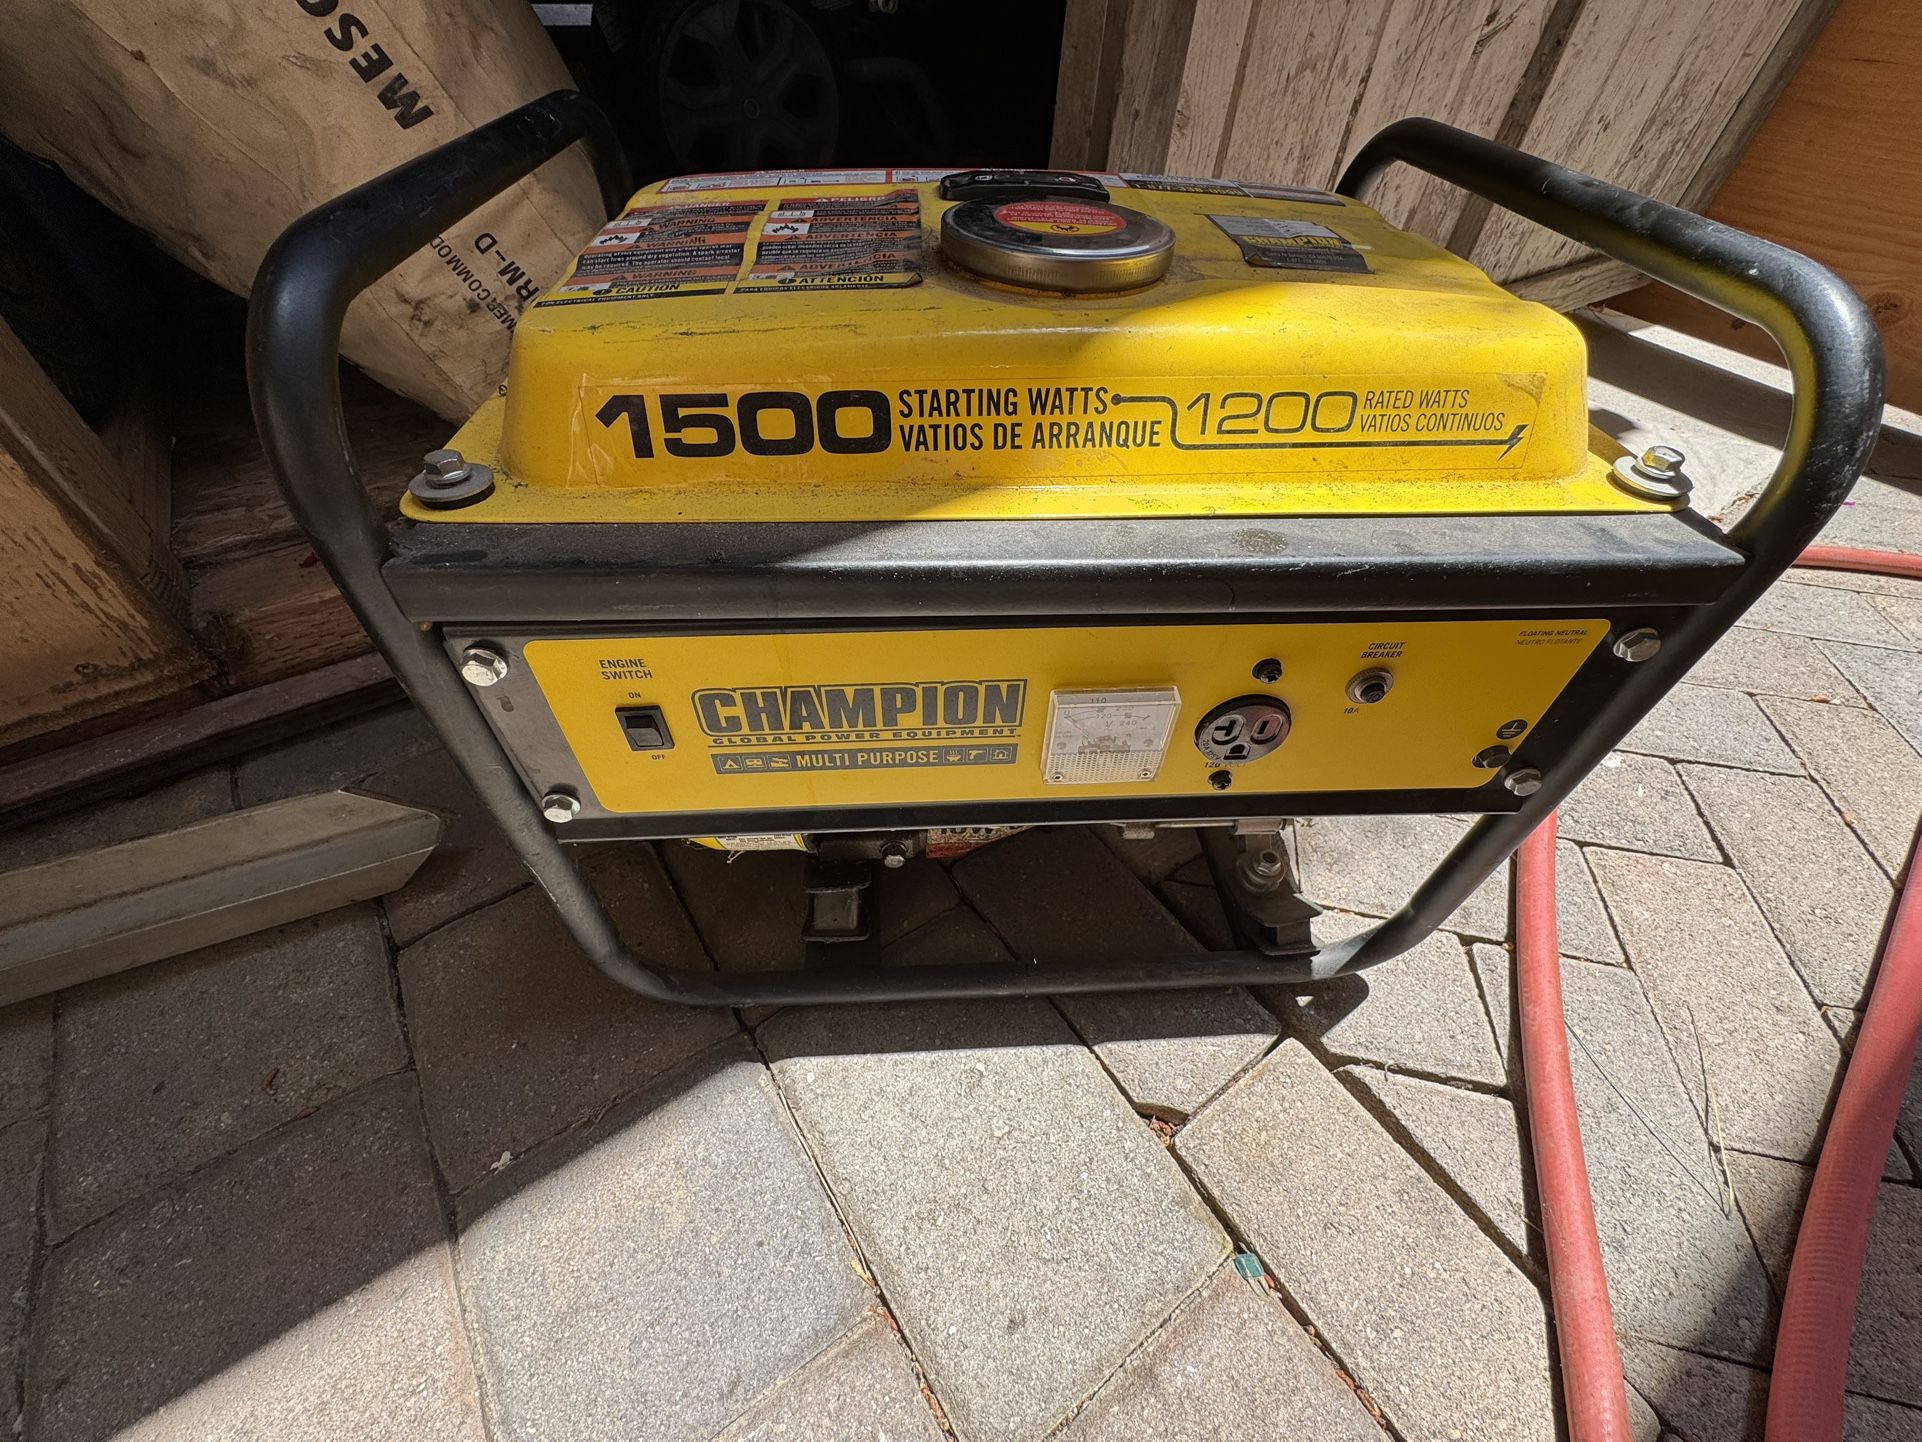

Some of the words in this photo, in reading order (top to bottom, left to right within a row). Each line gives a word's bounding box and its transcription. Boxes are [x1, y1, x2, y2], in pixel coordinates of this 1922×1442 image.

[658, 217, 716, 231] WARNING
[645, 236, 707, 249] WARNING
[474, 232, 541, 304] RM-D
[798, 274, 884, 285] ATTENCIÓN
[614, 283, 681, 295] CAUTION
[898, 388, 1018, 418] STARTING
[1027, 386, 1109, 416] WATTS
[1363, 390, 1414, 410] RATED
[1418, 389, 1470, 409] WATTS
[1186, 391, 1359, 436] 1200
[595, 390, 892, 459] 1500
[1360, 413, 1410, 433] VATIOS
[1415, 412, 1505, 432] CONTINUOS
[898, 422, 984, 452] VATIOS
[993, 422, 1023, 450] DE
[1031, 420, 1162, 449] ARRANQUE
[1518, 629, 1553, 637] FLOATING
[1368, 642, 1405, 650] CIRCUIT
[1515, 638, 1545, 646] NEUTRO
[1545, 637, 1583, 645] FLOTANTE
[1361, 650, 1403, 659] BREAKER
[599, 658, 647, 669] ENGINE
[601, 669, 653, 680] SWITCH
[628, 691, 642, 699] ON
[694, 681, 1025, 735] CHAMPION
[712, 735, 797, 745] GLOBAL
[804, 732, 881, 742] POWER
[892, 728, 1018, 739] EQUIPMENT
[795, 750, 850, 768] MULTI
[857, 749, 939, 765] PURPOSE
[1204, 761, 1221, 769] 120
